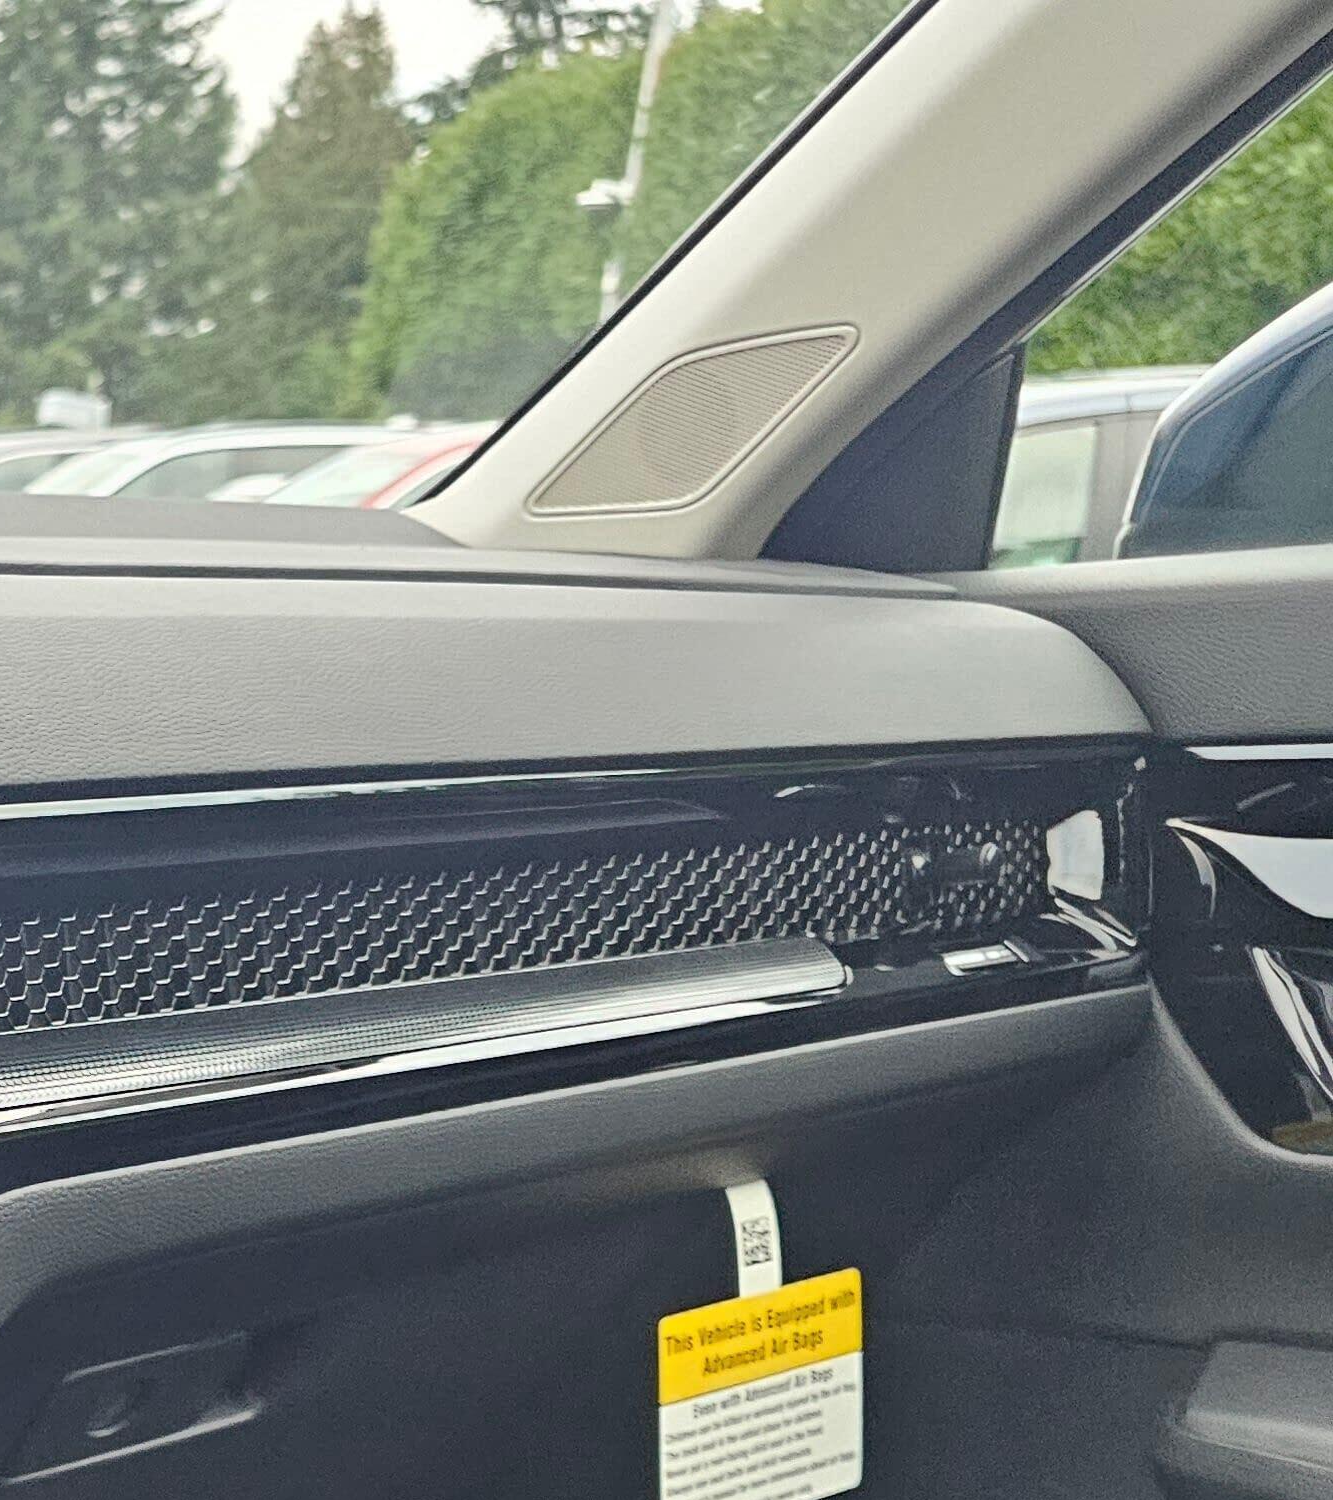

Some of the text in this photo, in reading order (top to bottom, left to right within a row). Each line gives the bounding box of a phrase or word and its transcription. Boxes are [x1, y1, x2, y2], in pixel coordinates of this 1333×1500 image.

[666, 1333, 695, 1357] This
[698, 1319, 747, 1347] Vehicle
[767, 1297, 826, 1330] Equipped
[829, 1289, 856, 1311] with
[702, 1330, 825, 1376] Advanced Air Bags
